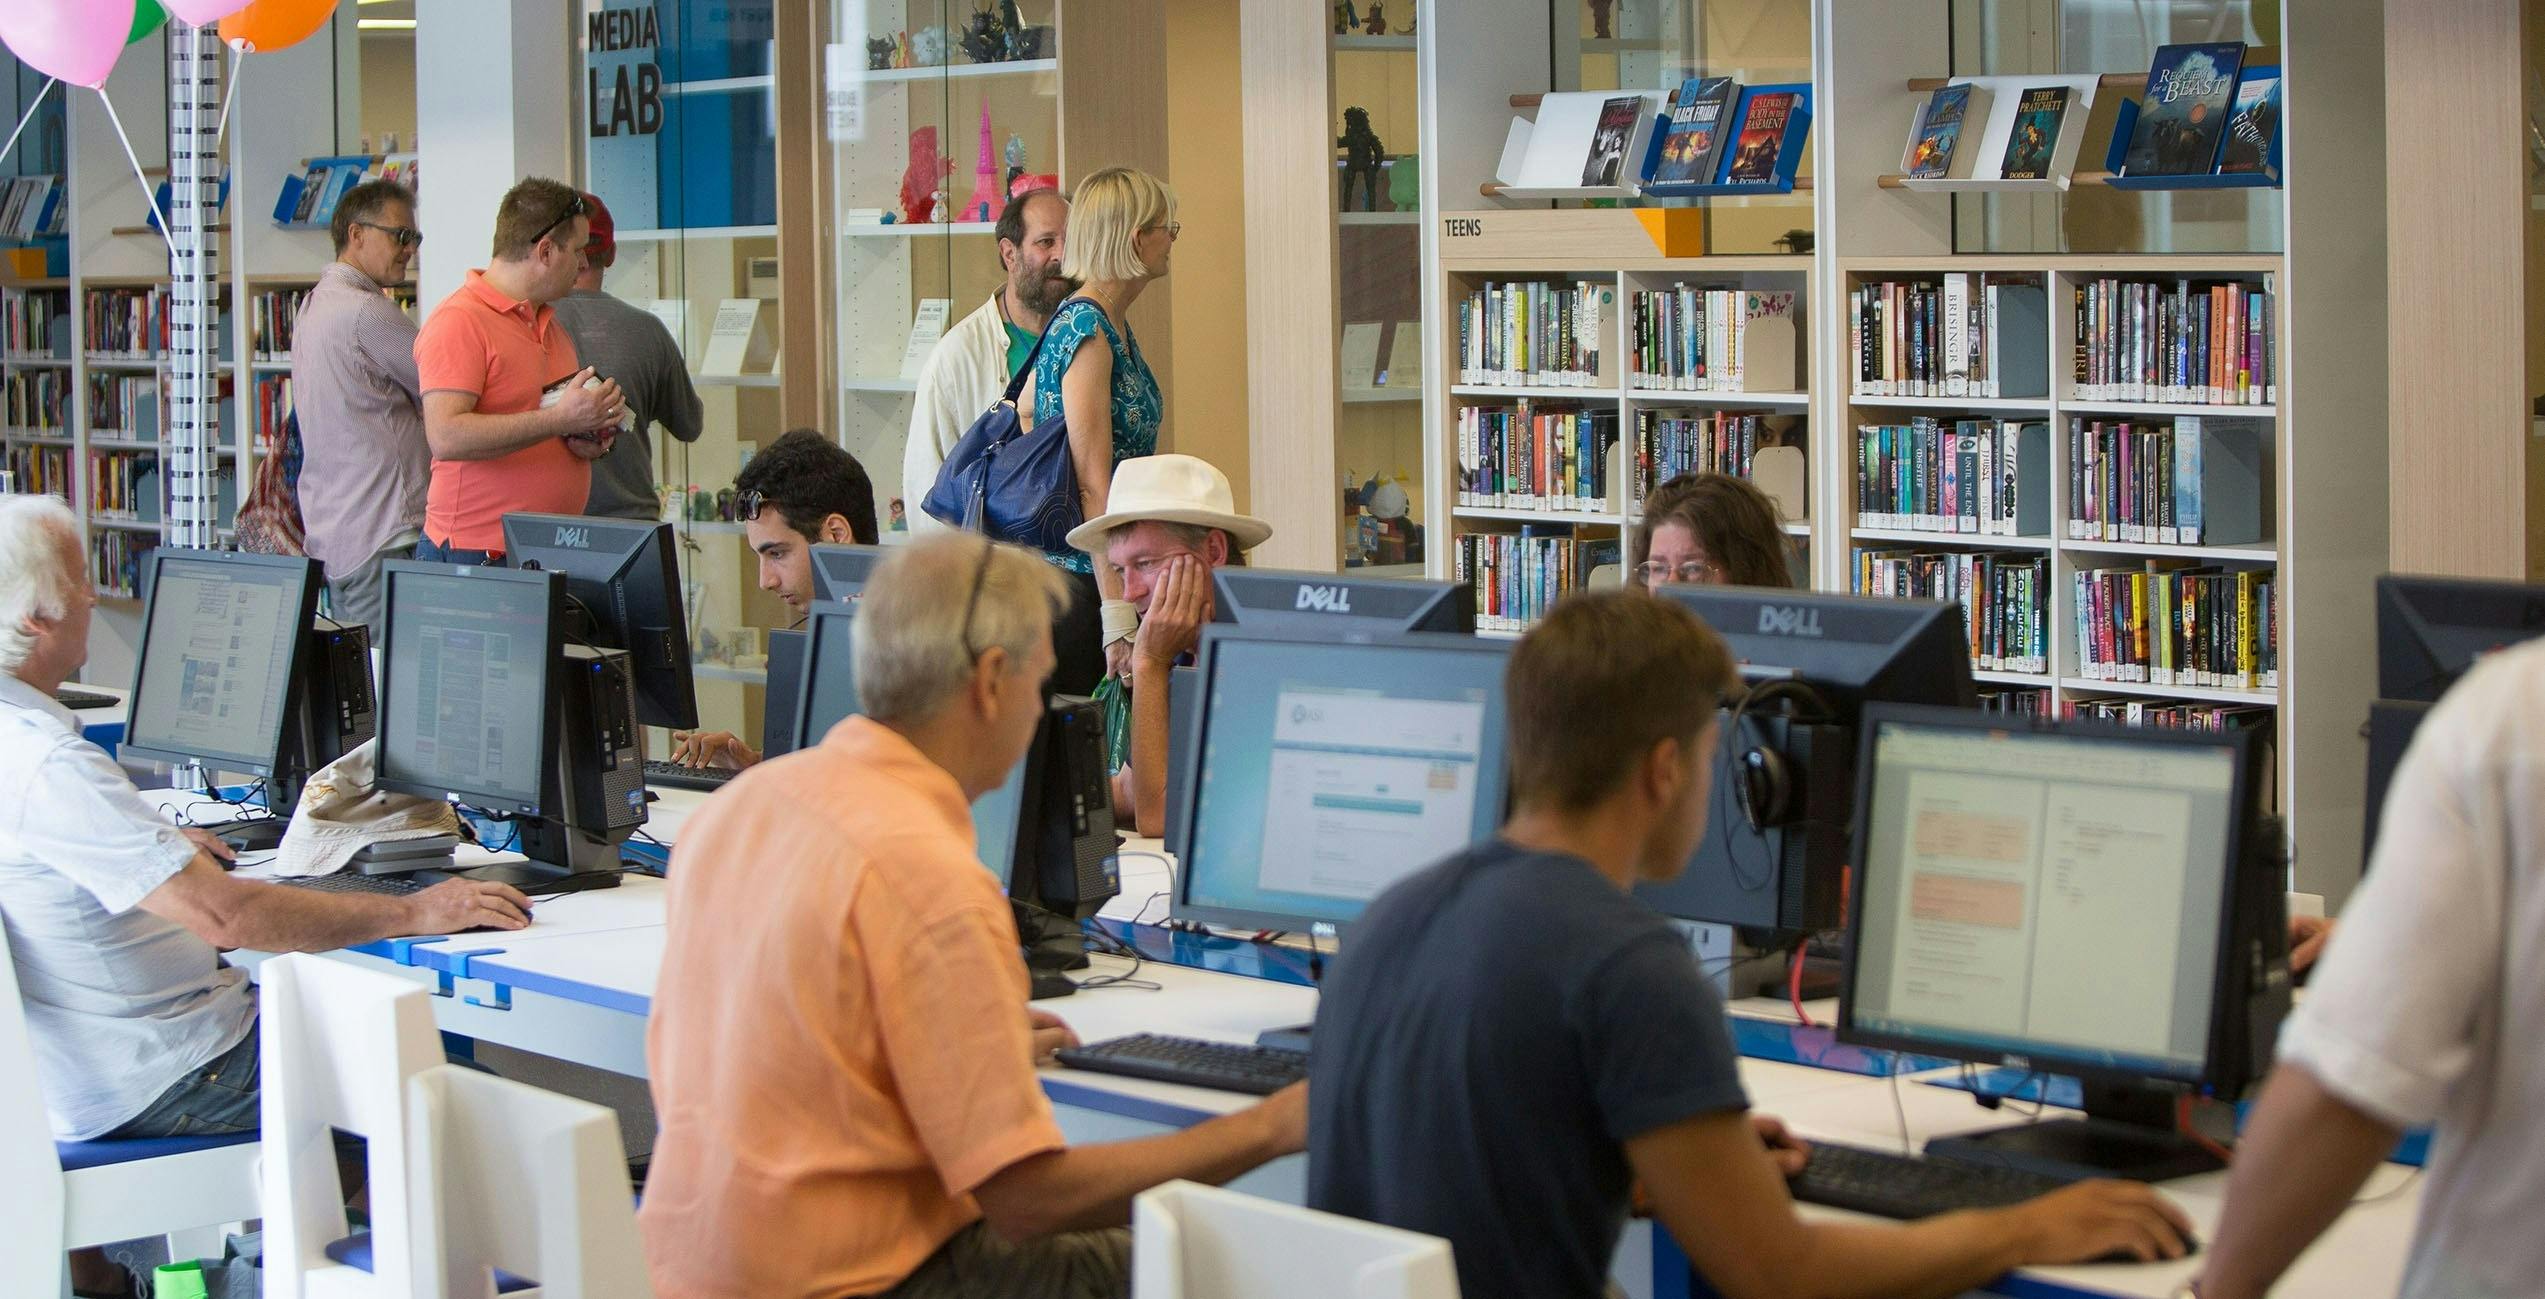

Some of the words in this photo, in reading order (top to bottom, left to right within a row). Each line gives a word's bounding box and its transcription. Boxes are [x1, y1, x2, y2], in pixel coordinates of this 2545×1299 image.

[589, 6, 660, 52] MEDIA
[2159, 69, 2208, 82] REQUIEM
[589, 63, 664, 137] LAB
[2033, 91, 2056, 101] TERRY
[2163, 79, 2226, 102] BEAST
[1672, 105, 1695, 124] BLACK
[1692, 104, 1720, 122] FRIDAY
[2020, 100, 2063, 112] PRATCHETT
[1745, 118, 1784, 130] BASEMENT
[2009, 171, 2035, 179] DODGER
[1445, 219, 1481, 236] TEENS
[1949, 294, 1958, 363] BRISINGR
[2076, 345, 2086, 379] FIRE
[1965, 500, 1973, 517] END
[554, 526, 590, 548] DELL
[1296, 584, 1351, 612] DELL
[1758, 604, 1823, 636] DELL
